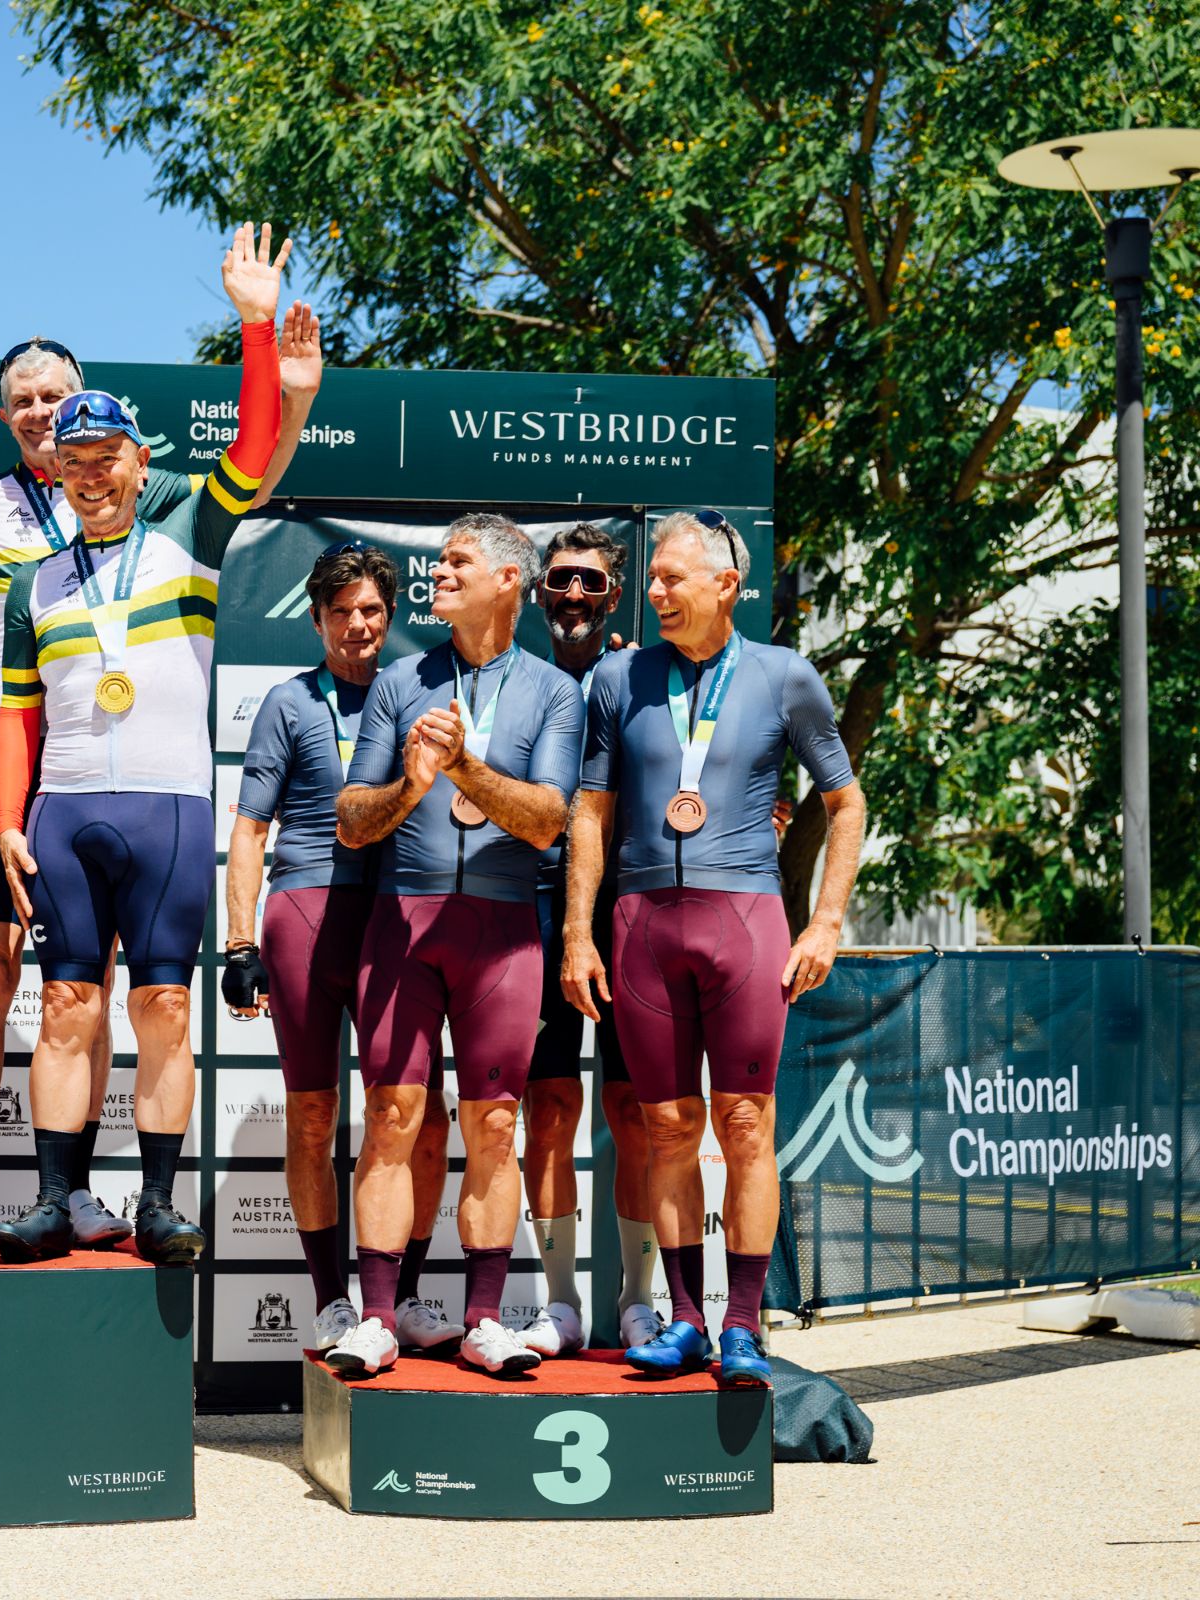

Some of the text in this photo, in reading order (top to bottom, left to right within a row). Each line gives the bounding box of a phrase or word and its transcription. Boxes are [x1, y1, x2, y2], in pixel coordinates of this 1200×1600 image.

[61, 428, 107, 441] wahoo
[449, 410, 737, 445] WESTBRIDGE
[493, 452, 692, 467] FUNDS MANAGEMENT
[944, 1065, 1079, 1114] National
[225, 1103, 285, 1114] WESTB
[949, 1122, 1173, 1186] Championships
[238, 1197, 291, 1208] WESTE
[232, 1212, 296, 1222] AUSTRA
[532, 1410, 611, 1505] 3
[68, 1470, 166, 1487] WESTBRIDGE
[415, 1472, 448, 1480] National
[664, 1470, 755, 1486] WESTBRIDGE
[415, 1480, 476, 1491] Championships
